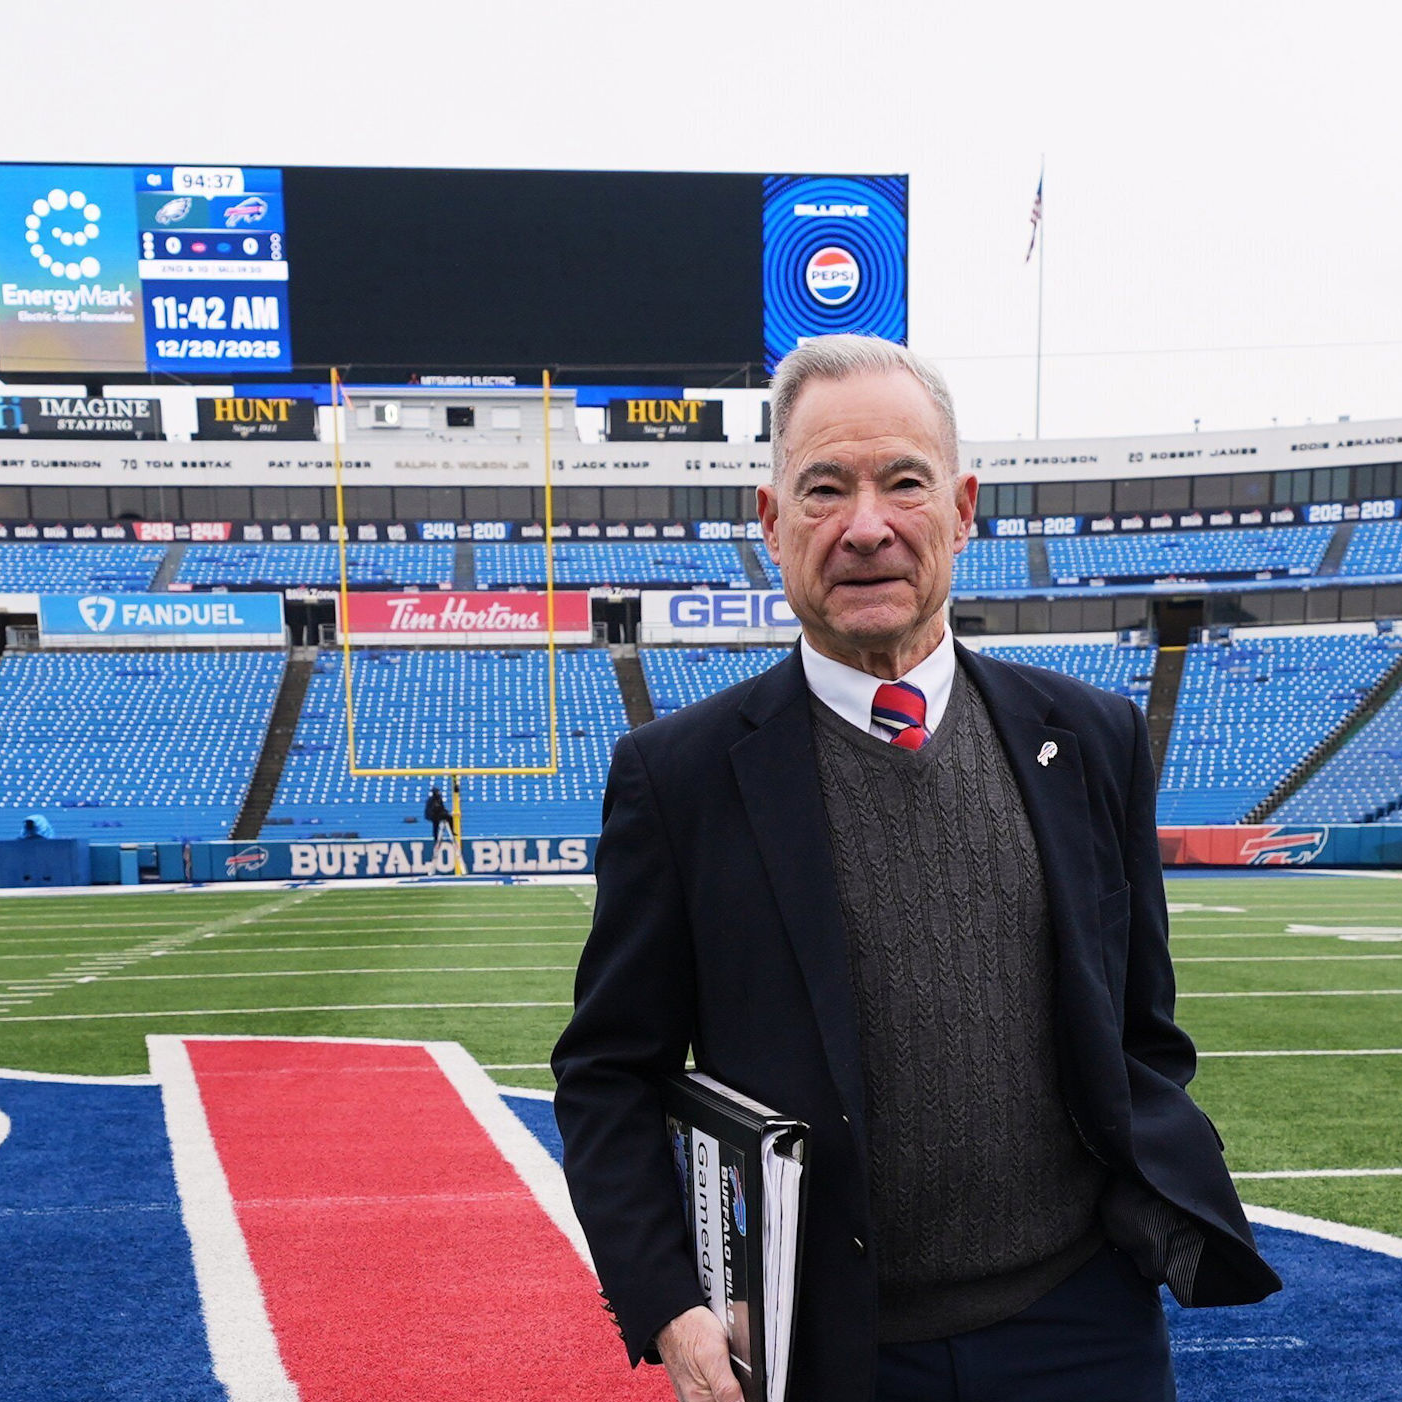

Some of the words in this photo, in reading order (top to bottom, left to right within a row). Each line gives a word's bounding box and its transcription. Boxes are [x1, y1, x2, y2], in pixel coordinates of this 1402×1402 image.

[182, 174, 234, 189] 94:37
[811, 270, 854, 281] PEPSI
[2, 283, 133, 312] EnergyMark
[151, 296, 226, 329] 11:42
[231, 296, 280, 330] AM
[155, 339, 281, 358] 12/28/2025
[472, 376, 516, 386] ELECTRIC
[38, 398, 150, 417] IMAGINE
[214, 398, 292, 422] HUNT
[626, 399, 702, 423] HUNT
[57, 419, 133, 431] STAFFING
[1150, 450, 1203, 460] ROBERT
[1209, 447, 1257, 456] JAMES
[1291, 442, 1329, 451] EDDIE
[31, 460, 101, 468] DUBENION
[145, 461, 173, 469] TOM
[181, 461, 232, 469] SESTAK
[268, 461, 291, 469] PAT
[458, 461, 508, 469] WILSON
[572, 461, 606, 469] JACK
[614, 461, 650, 469] KEMP
[710, 461, 742, 469] BILLY
[1025, 456, 1098, 465] FERGUSON
[1309, 504, 1342, 523] 202
[1360, 501, 1395, 519] 203
[140, 522, 174, 541] 243
[191, 522, 225, 541] 244
[422, 523, 455, 540] 244
[473, 522, 506, 540] 200
[699, 522, 731, 539] 200
[996, 518, 1027, 536] 201
[1044, 517, 1076, 535] 202
[122, 603, 244, 626] FANDUEL
[387, 598, 435, 630] Tim
[439, 597, 539, 630] Hortons
[670, 594, 800, 628] GEIC
[290, 843, 454, 876] BUFFALO
[472, 839, 589, 872] BILLS
[719, 1164, 733, 1262] BUFFALO
[724, 1263, 736, 1326] BILLS
